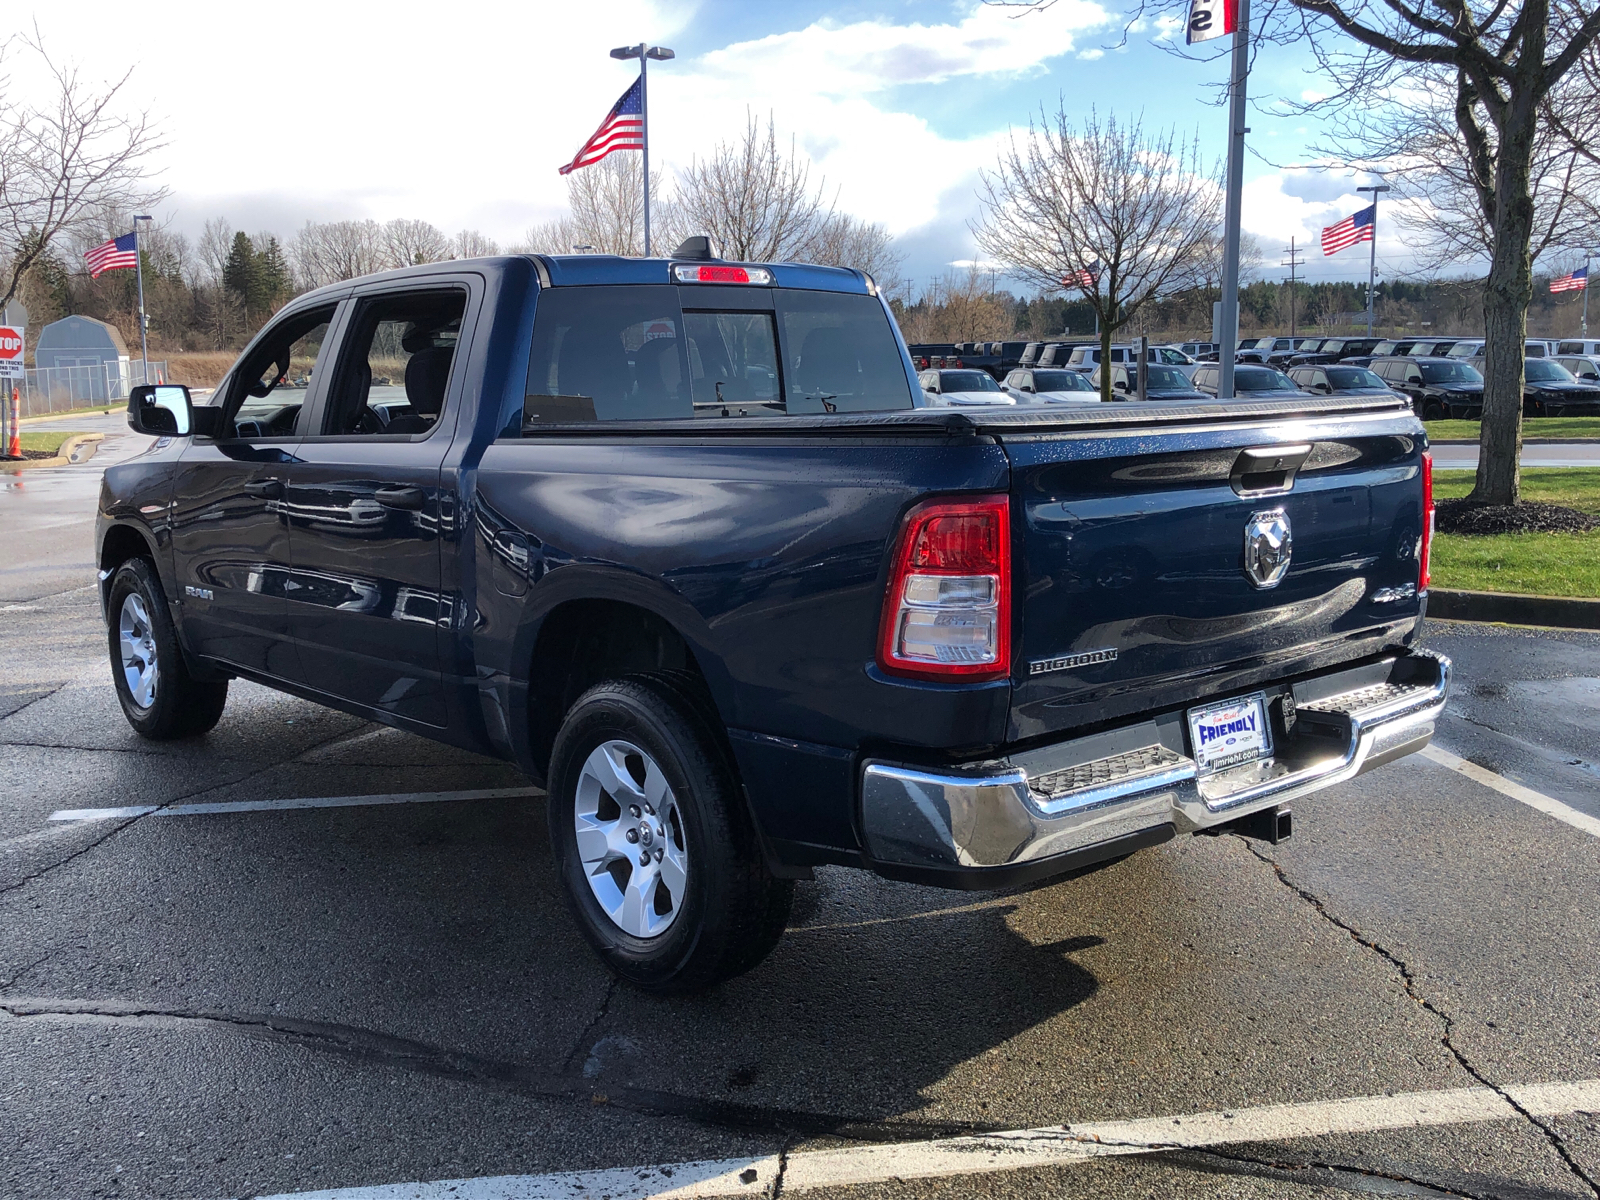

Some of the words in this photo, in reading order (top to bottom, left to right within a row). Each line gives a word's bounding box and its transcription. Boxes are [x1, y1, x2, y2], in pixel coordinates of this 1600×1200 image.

[185, 586, 214, 601] RAM
[1029, 647, 1118, 675] BIGHORN
[1198, 710, 1256, 746] FRIENDLY
